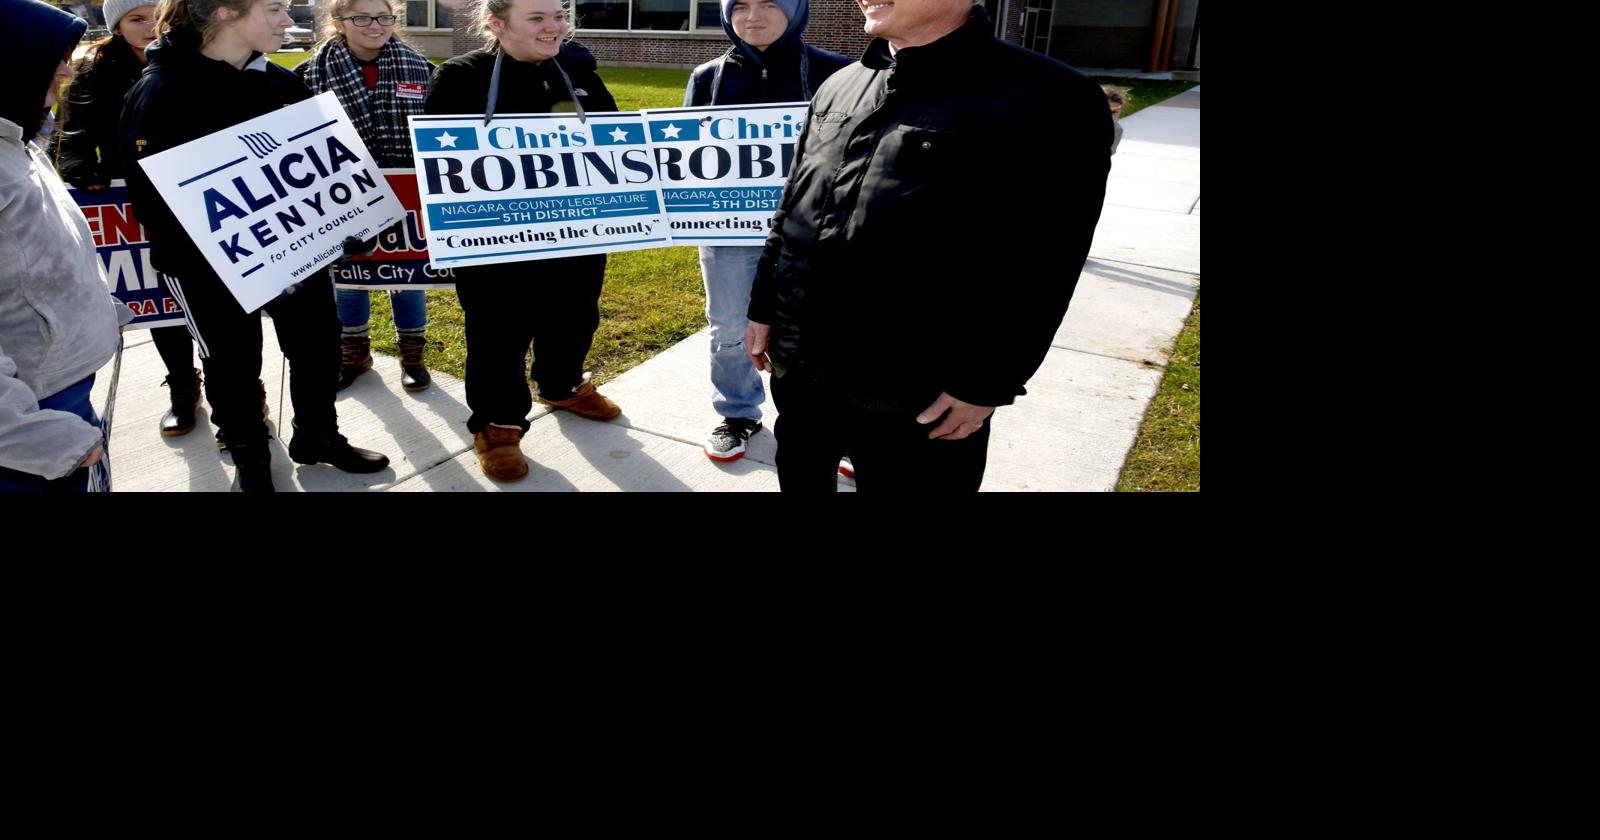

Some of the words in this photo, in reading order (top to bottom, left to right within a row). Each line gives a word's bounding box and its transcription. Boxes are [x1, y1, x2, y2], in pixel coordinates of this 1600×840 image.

[488, 125, 587, 149] Chris
[420, 150, 654, 195] ROBINS
[653, 143, 796, 181] ROBI
[203, 136, 361, 233] ALICIA
[724, 189, 778, 199] COUNTY
[441, 204, 506, 215] NIAGARA
[508, 199, 564, 211] COUNTY
[567, 193, 648, 208] LEGISLATURE
[503, 212, 531, 223] 5TH
[535, 206, 598, 220] DISTRICT
[712, 200, 740, 209] 5TH
[745, 199, 778, 208] DIST
[218, 168, 377, 265] KENYON
[670, 217, 763, 232] onnecting
[270, 249, 287, 263] for
[289, 231, 315, 251] CITY
[318, 206, 364, 236] COUNCIL
[559, 226, 589, 239] the
[377, 264, 415, 283] City
